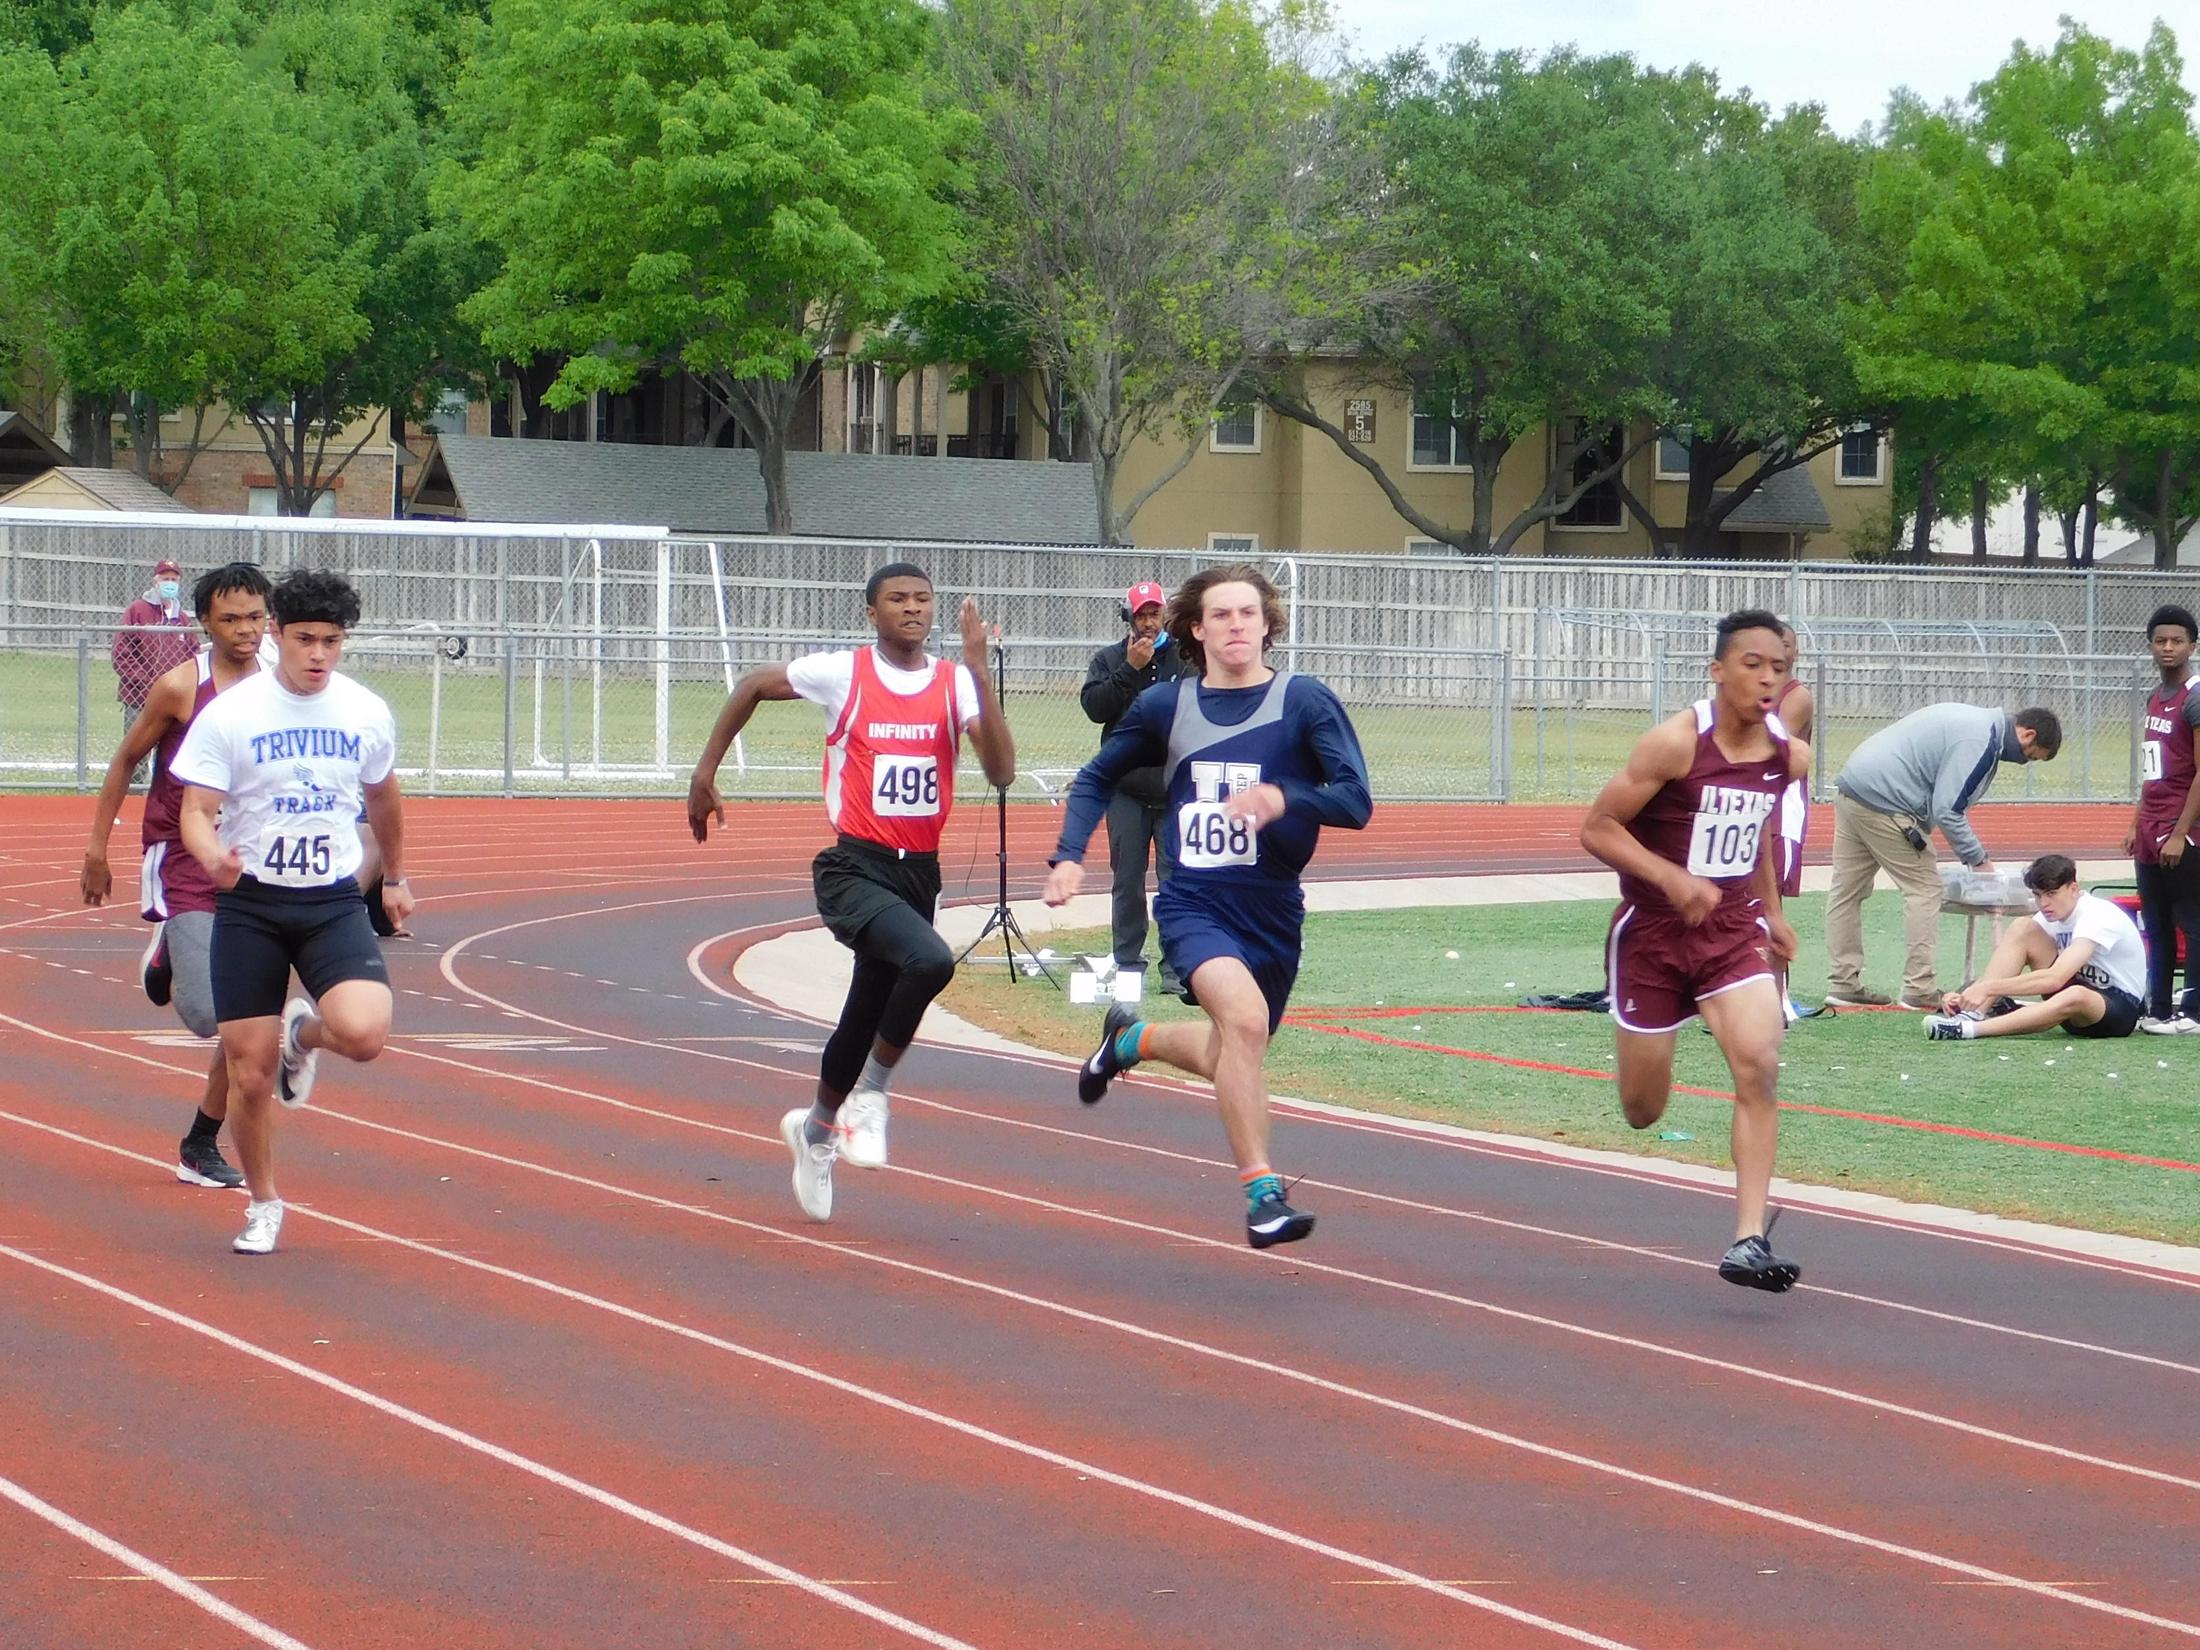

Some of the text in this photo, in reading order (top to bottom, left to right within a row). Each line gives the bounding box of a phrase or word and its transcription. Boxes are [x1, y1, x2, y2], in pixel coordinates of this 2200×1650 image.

[1355, 415, 1365, 430] 5
[252, 726, 361, 764] TRIVIUM
[868, 722, 938, 740] INFINITY
[273, 794, 337, 814] TRACK
[877, 765, 938, 805] 498
[1186, 813, 1249, 856] 468
[1705, 822, 1757, 865] 103
[264, 834, 331, 876] 445
